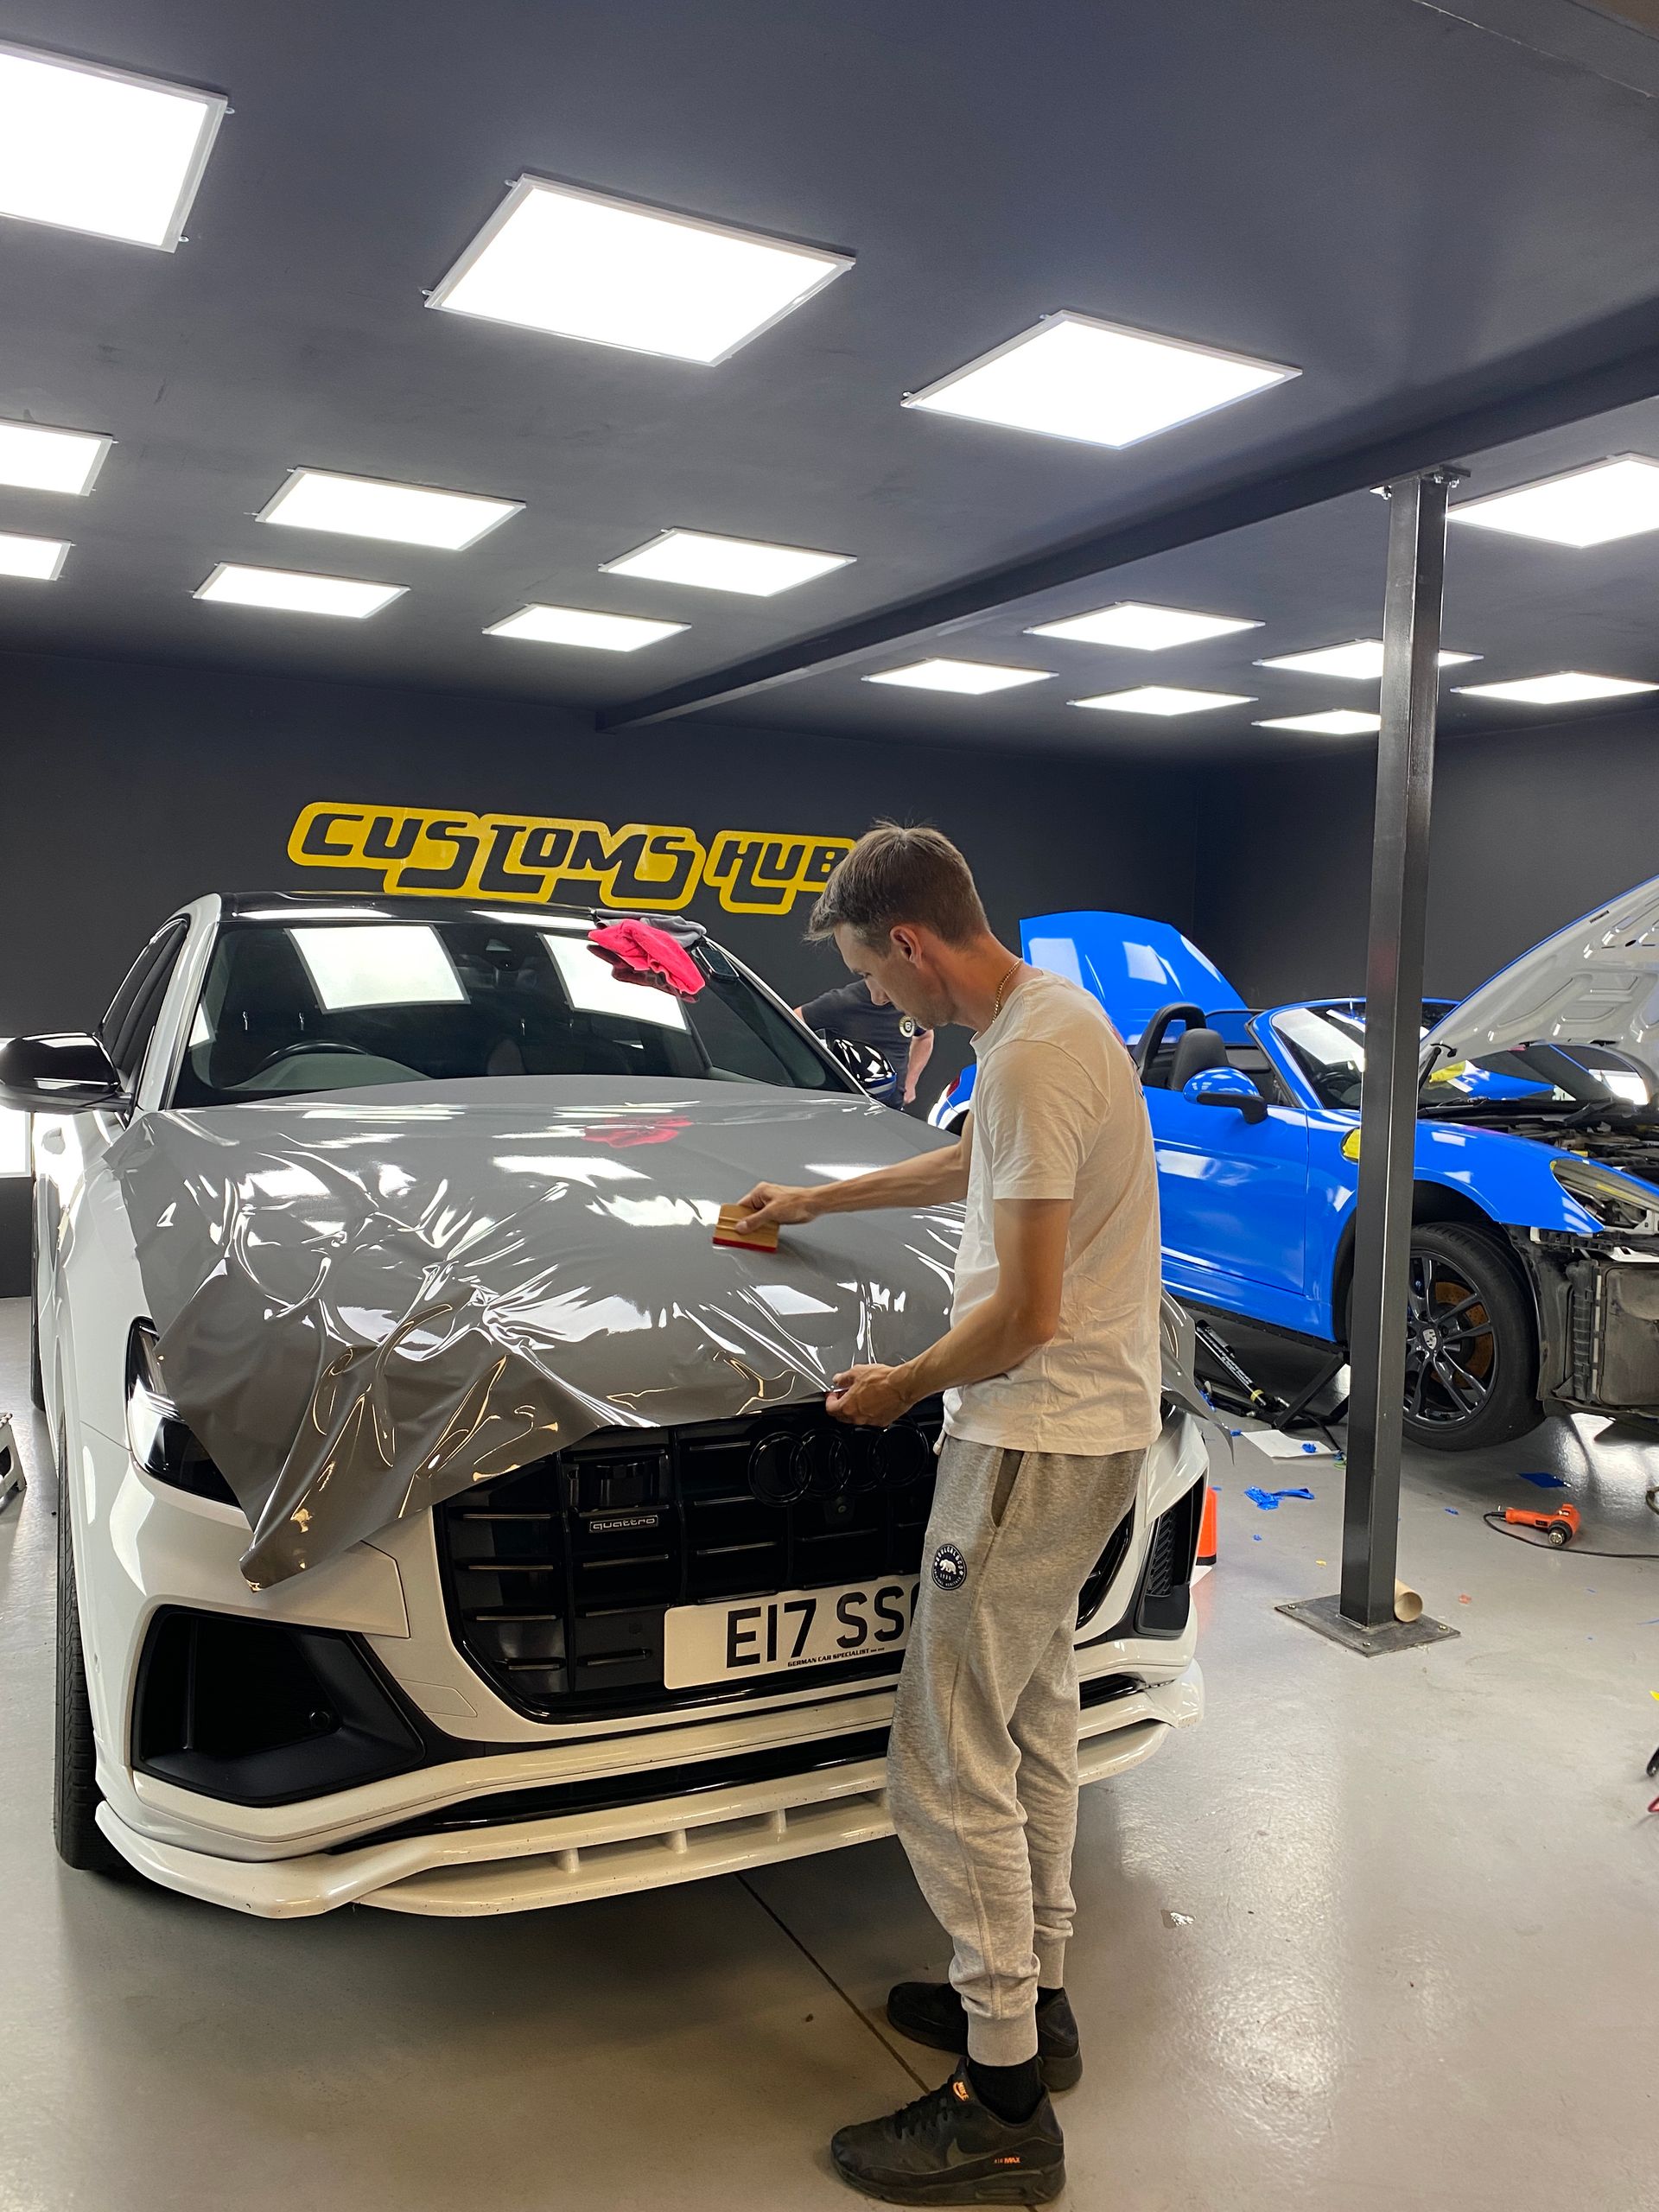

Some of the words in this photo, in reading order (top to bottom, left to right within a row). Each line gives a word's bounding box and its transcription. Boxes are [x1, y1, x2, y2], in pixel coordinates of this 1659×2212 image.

[301, 812, 696, 900] CUSTOMS
[713, 839, 850, 906] HUB
[592, 1517, 656, 1531] quattro
[726, 1598, 817, 1669] E17
[787, 1657, 817, 1668] GERMAN
[817, 1654, 832, 1662] CAR
[832, 1648, 870, 1660] SPECIALIST
